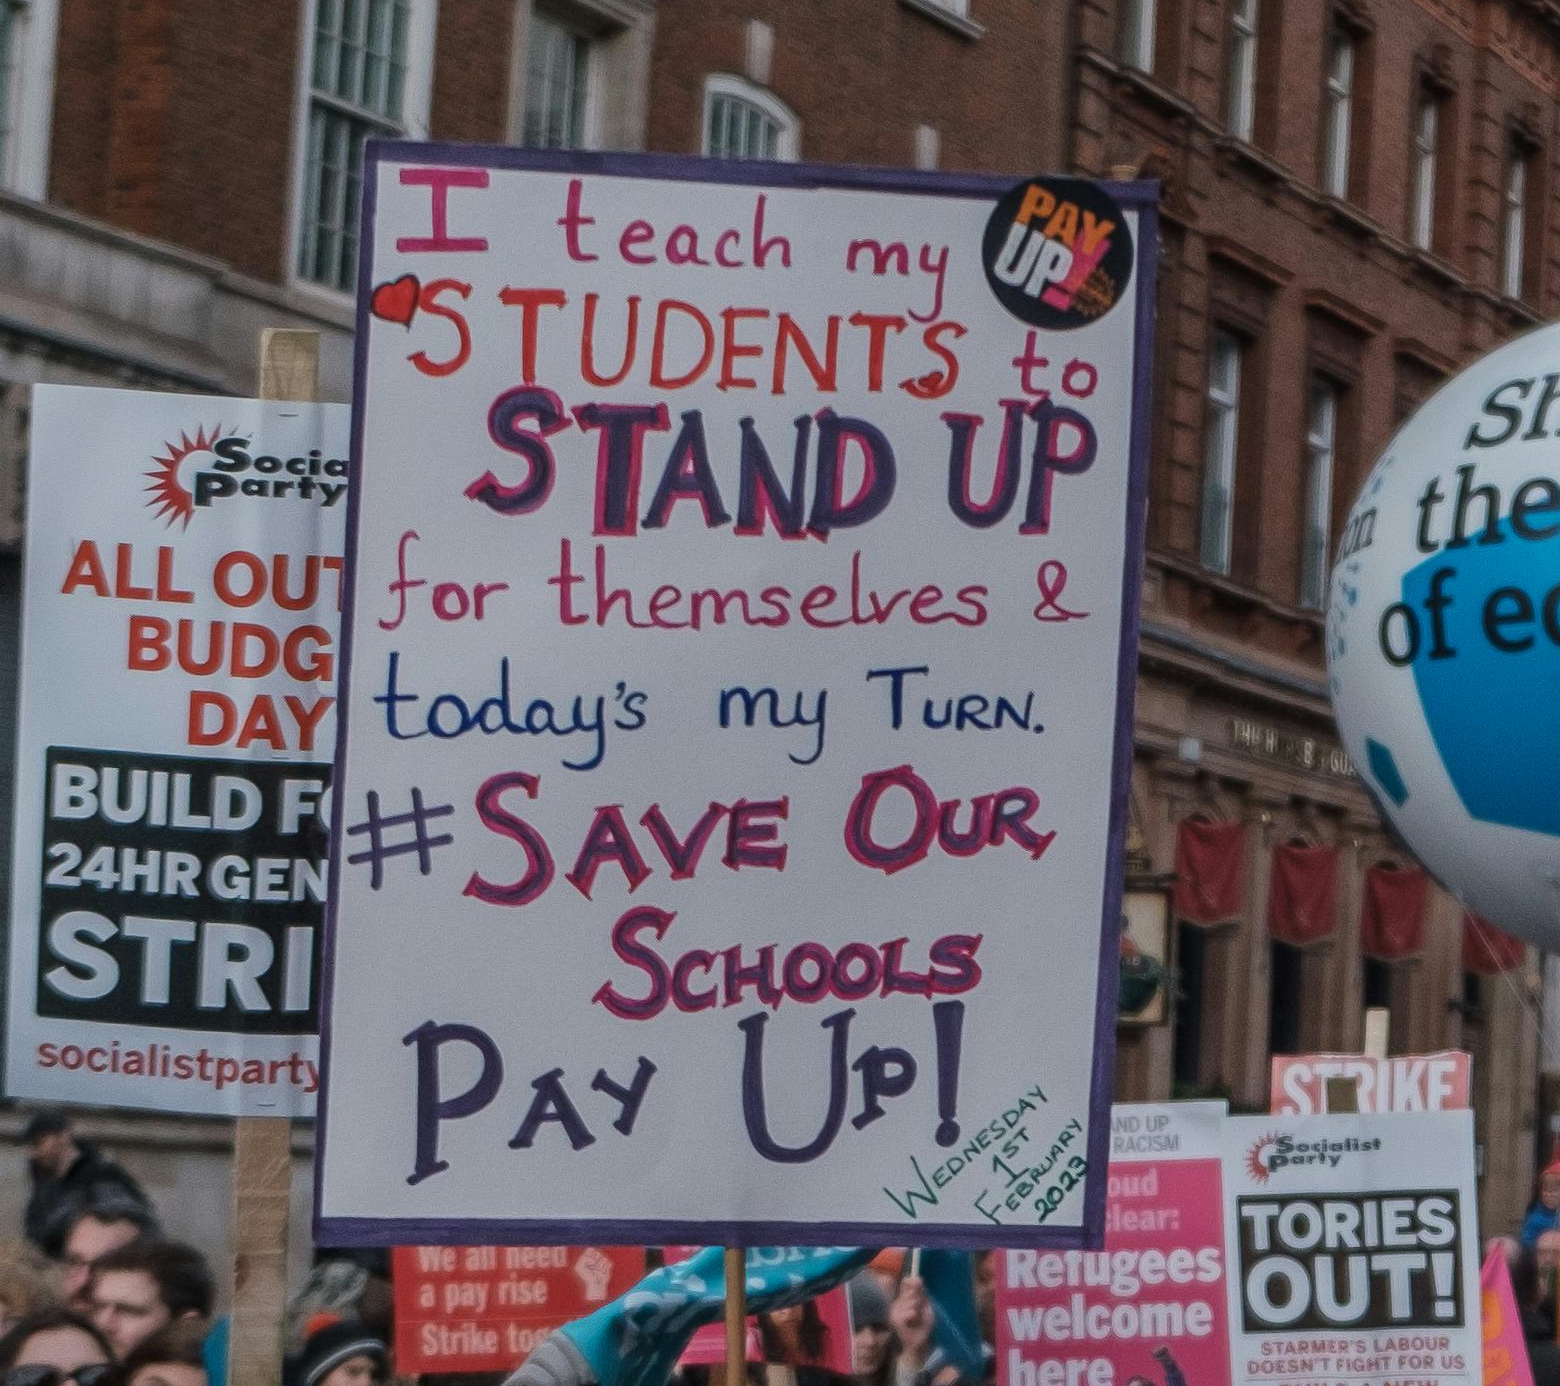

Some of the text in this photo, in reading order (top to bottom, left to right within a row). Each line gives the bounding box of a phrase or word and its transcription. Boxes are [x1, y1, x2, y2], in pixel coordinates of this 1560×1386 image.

[395, 167, 952, 323] I teach my
[1015, 184, 1116, 255] PAY
[405, 278, 1099, 401] STUDENTS to
[212, 437, 349, 476] Socia
[464, 385, 1098, 543] STAND UP
[61, 539, 194, 605] ALL
[377, 531, 1091, 634] for themselves &
[128, 615, 334, 683] BUDG
[1377, 566, 1458, 668] of
[187, 690, 336, 750] DAY
[372, 653, 650, 772] today's
[717, 683, 829, 765] my
[51, 763, 263, 830] BUILD
[844, 764, 1059, 875] OUR
[44, 842, 201, 897] 24HR
[592, 905, 986, 1021] SCHOOLS
[402, 1021, 659, 1186] PAY
[1281, 1060, 1457, 1115] STRIKE
[883, 1084, 1049, 1220] WEDNESDAY
[1114, 1135, 1180, 1153] RACISM
[1145, 1116, 1169, 1132] UP
[1275, 1135, 1382, 1154] Socialist
[973, 1117, 1083, 1226] FEBRUARY
[1034, 1155, 1088, 1224] 2023
[1241, 1197, 1457, 1251] TORIES
[419, 1276, 548, 1317] a pay rise
[1006, 1248, 1222, 1297] Refugees
[1246, 1252, 1456, 1324] OUT!
[421, 1324, 499, 1357] Strike
[1007, 1293, 1213, 1341] welcome
[1261, 1336, 1450, 1356] STARMER'S LABOUR
[1247, 1355, 1465, 1375] DOESN'T FIGHT FOR US
